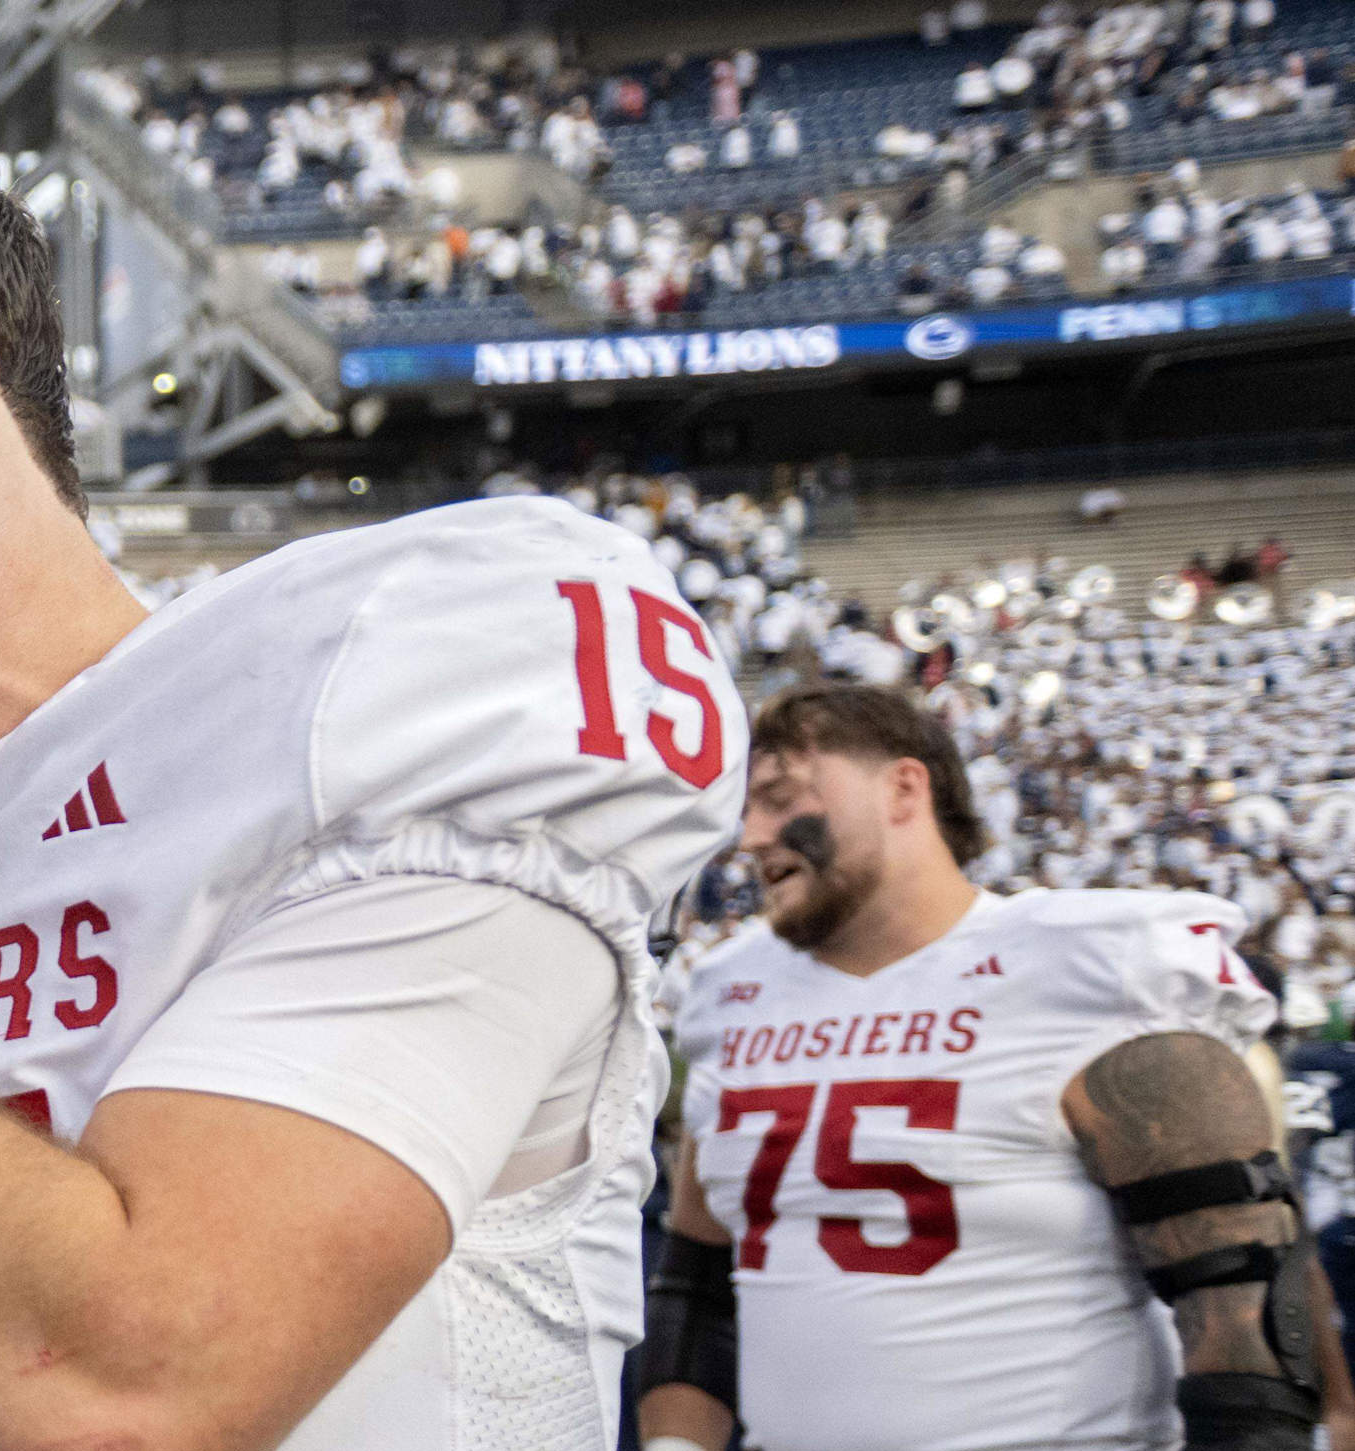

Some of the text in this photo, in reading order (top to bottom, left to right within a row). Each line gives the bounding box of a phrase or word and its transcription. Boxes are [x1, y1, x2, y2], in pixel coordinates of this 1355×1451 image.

[474, 335, 684, 385] NITTANY
[686, 324, 841, 376] LIONS
[556, 580, 723, 789] 15
[721, 1007, 983, 1069] HOOSIERS
[716, 1080, 961, 1275] 75
